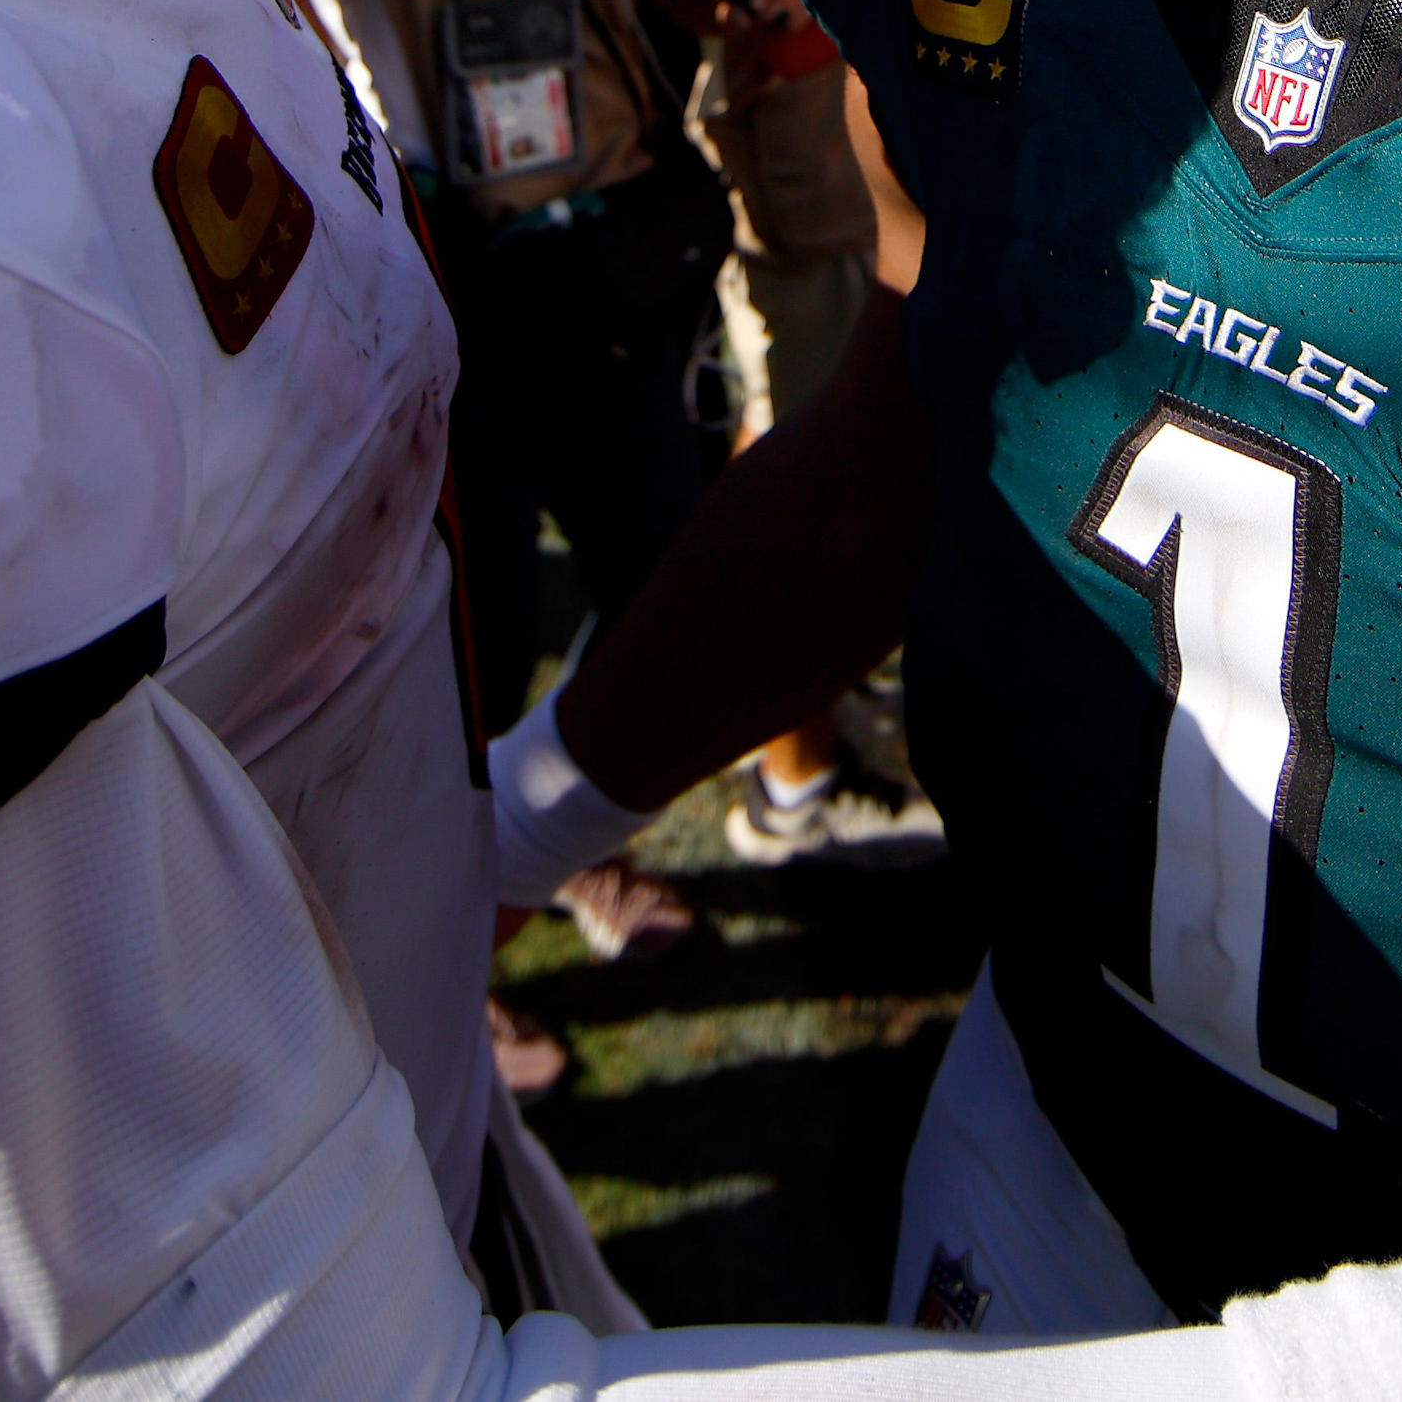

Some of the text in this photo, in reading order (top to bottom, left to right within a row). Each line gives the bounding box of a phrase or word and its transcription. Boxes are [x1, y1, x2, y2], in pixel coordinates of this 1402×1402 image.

[175, 85, 281, 280] C
[1248, 68, 1310, 127] NFL
[1144, 279, 1388, 428] EAGLES
[1066, 389, 1341, 1133] 1
